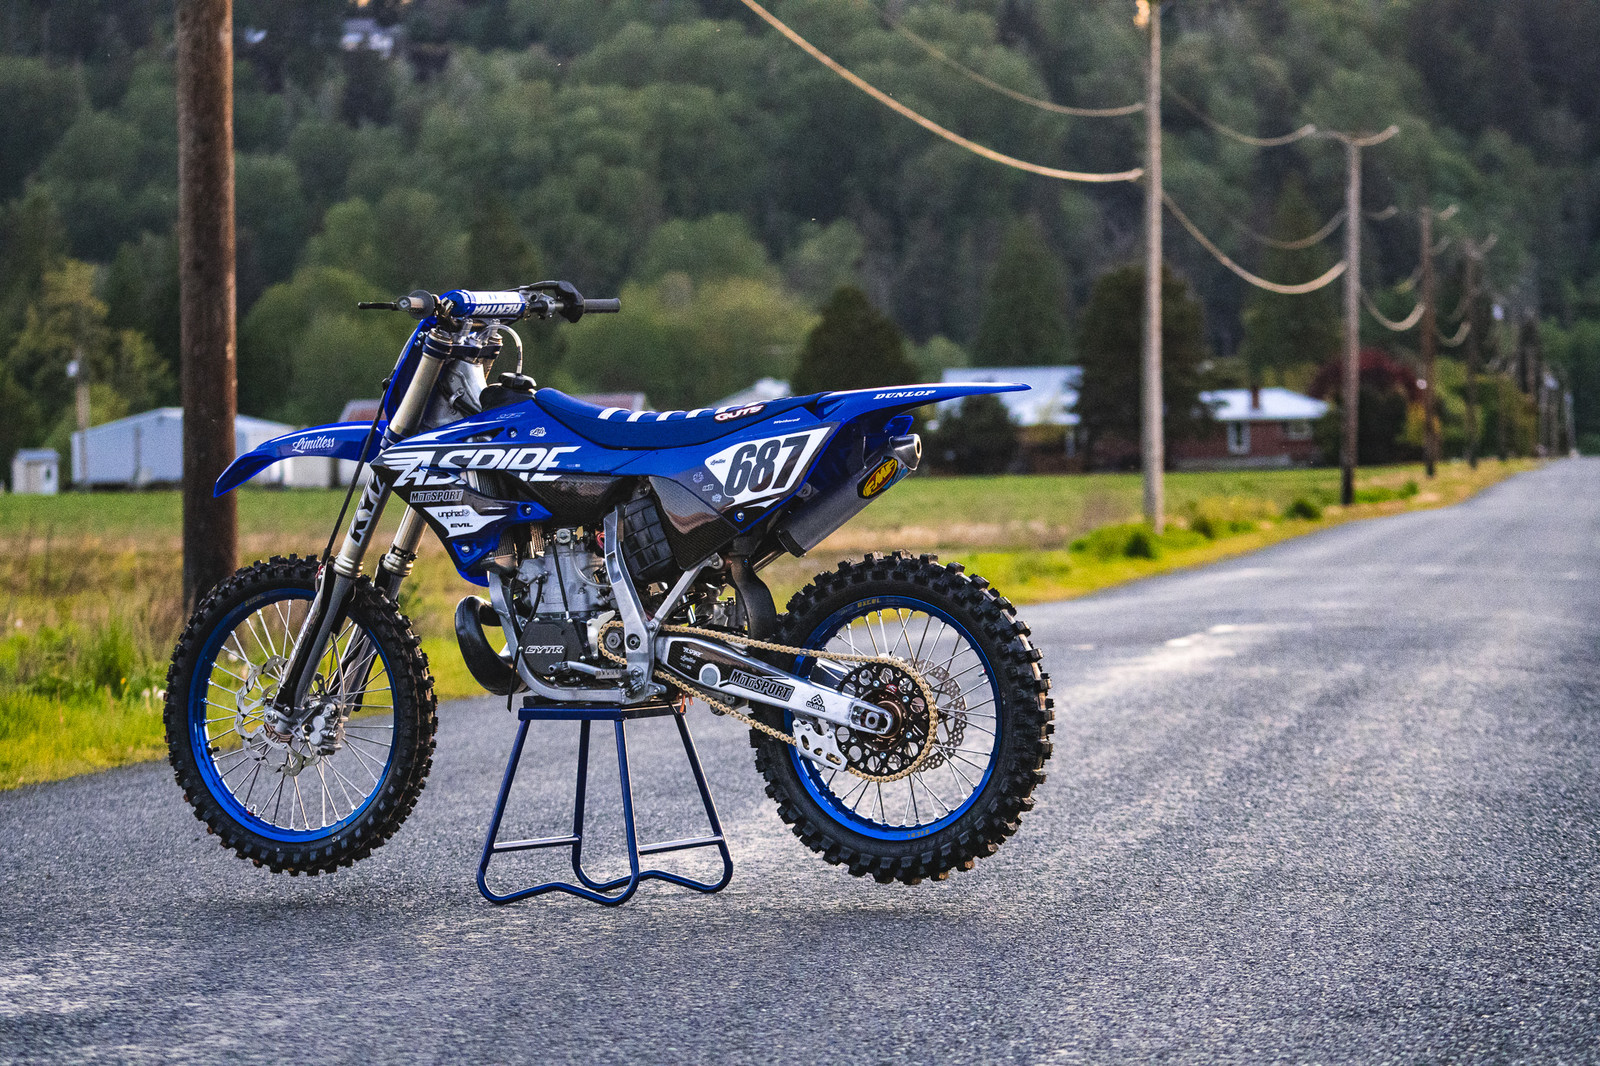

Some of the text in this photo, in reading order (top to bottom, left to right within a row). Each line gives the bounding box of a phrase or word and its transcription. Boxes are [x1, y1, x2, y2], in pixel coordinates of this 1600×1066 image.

[873, 390, 936, 400] DUNLOP
[714, 404, 764, 421] GUTS
[292, 435, 335, 453] Limitless
[382, 446, 581, 487] ASPIRE
[724, 434, 811, 496] 687
[863, 459, 896, 497] FMF
[525, 645, 564, 654] GYTR
